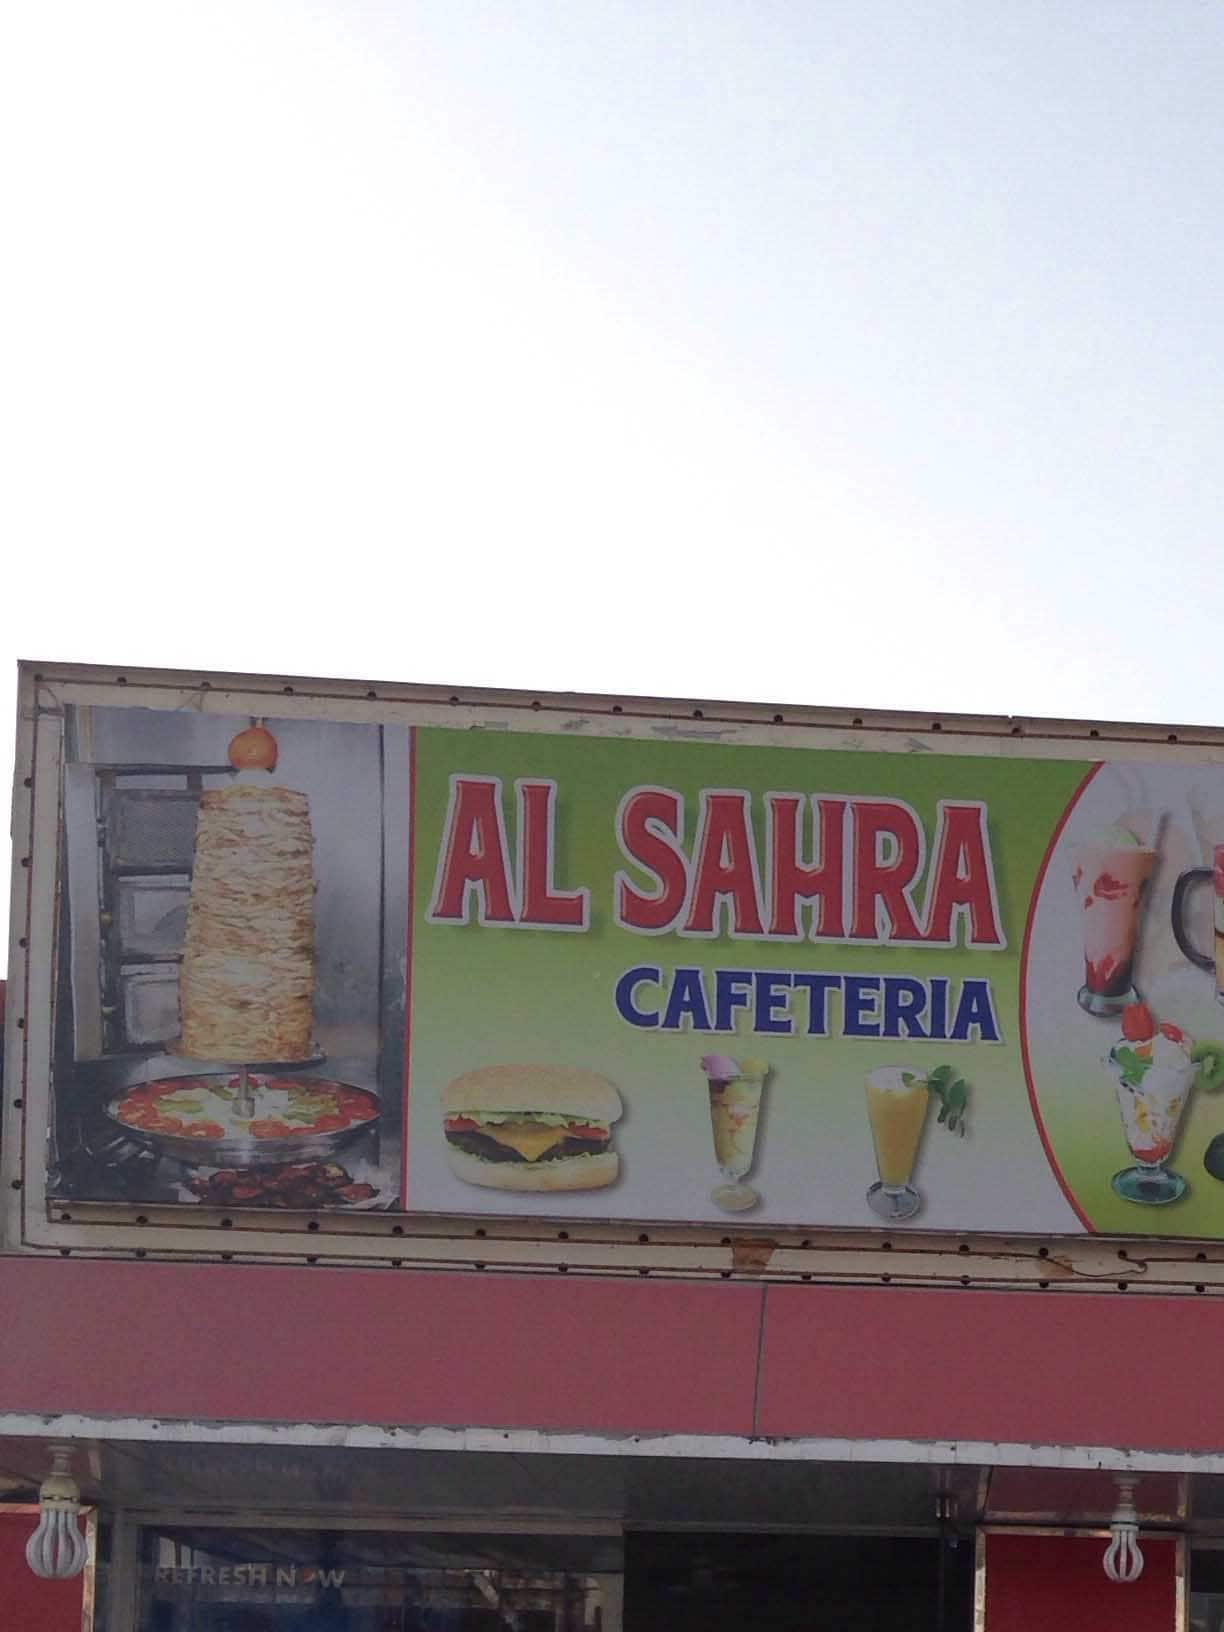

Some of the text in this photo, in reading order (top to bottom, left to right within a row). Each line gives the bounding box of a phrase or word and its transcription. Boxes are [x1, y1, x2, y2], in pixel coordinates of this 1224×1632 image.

[430, 775, 1007, 949] AL SAHRA
[613, 965, 1004, 1043] CAFETERIA
[155, 1562, 267, 1586] REFRESH
